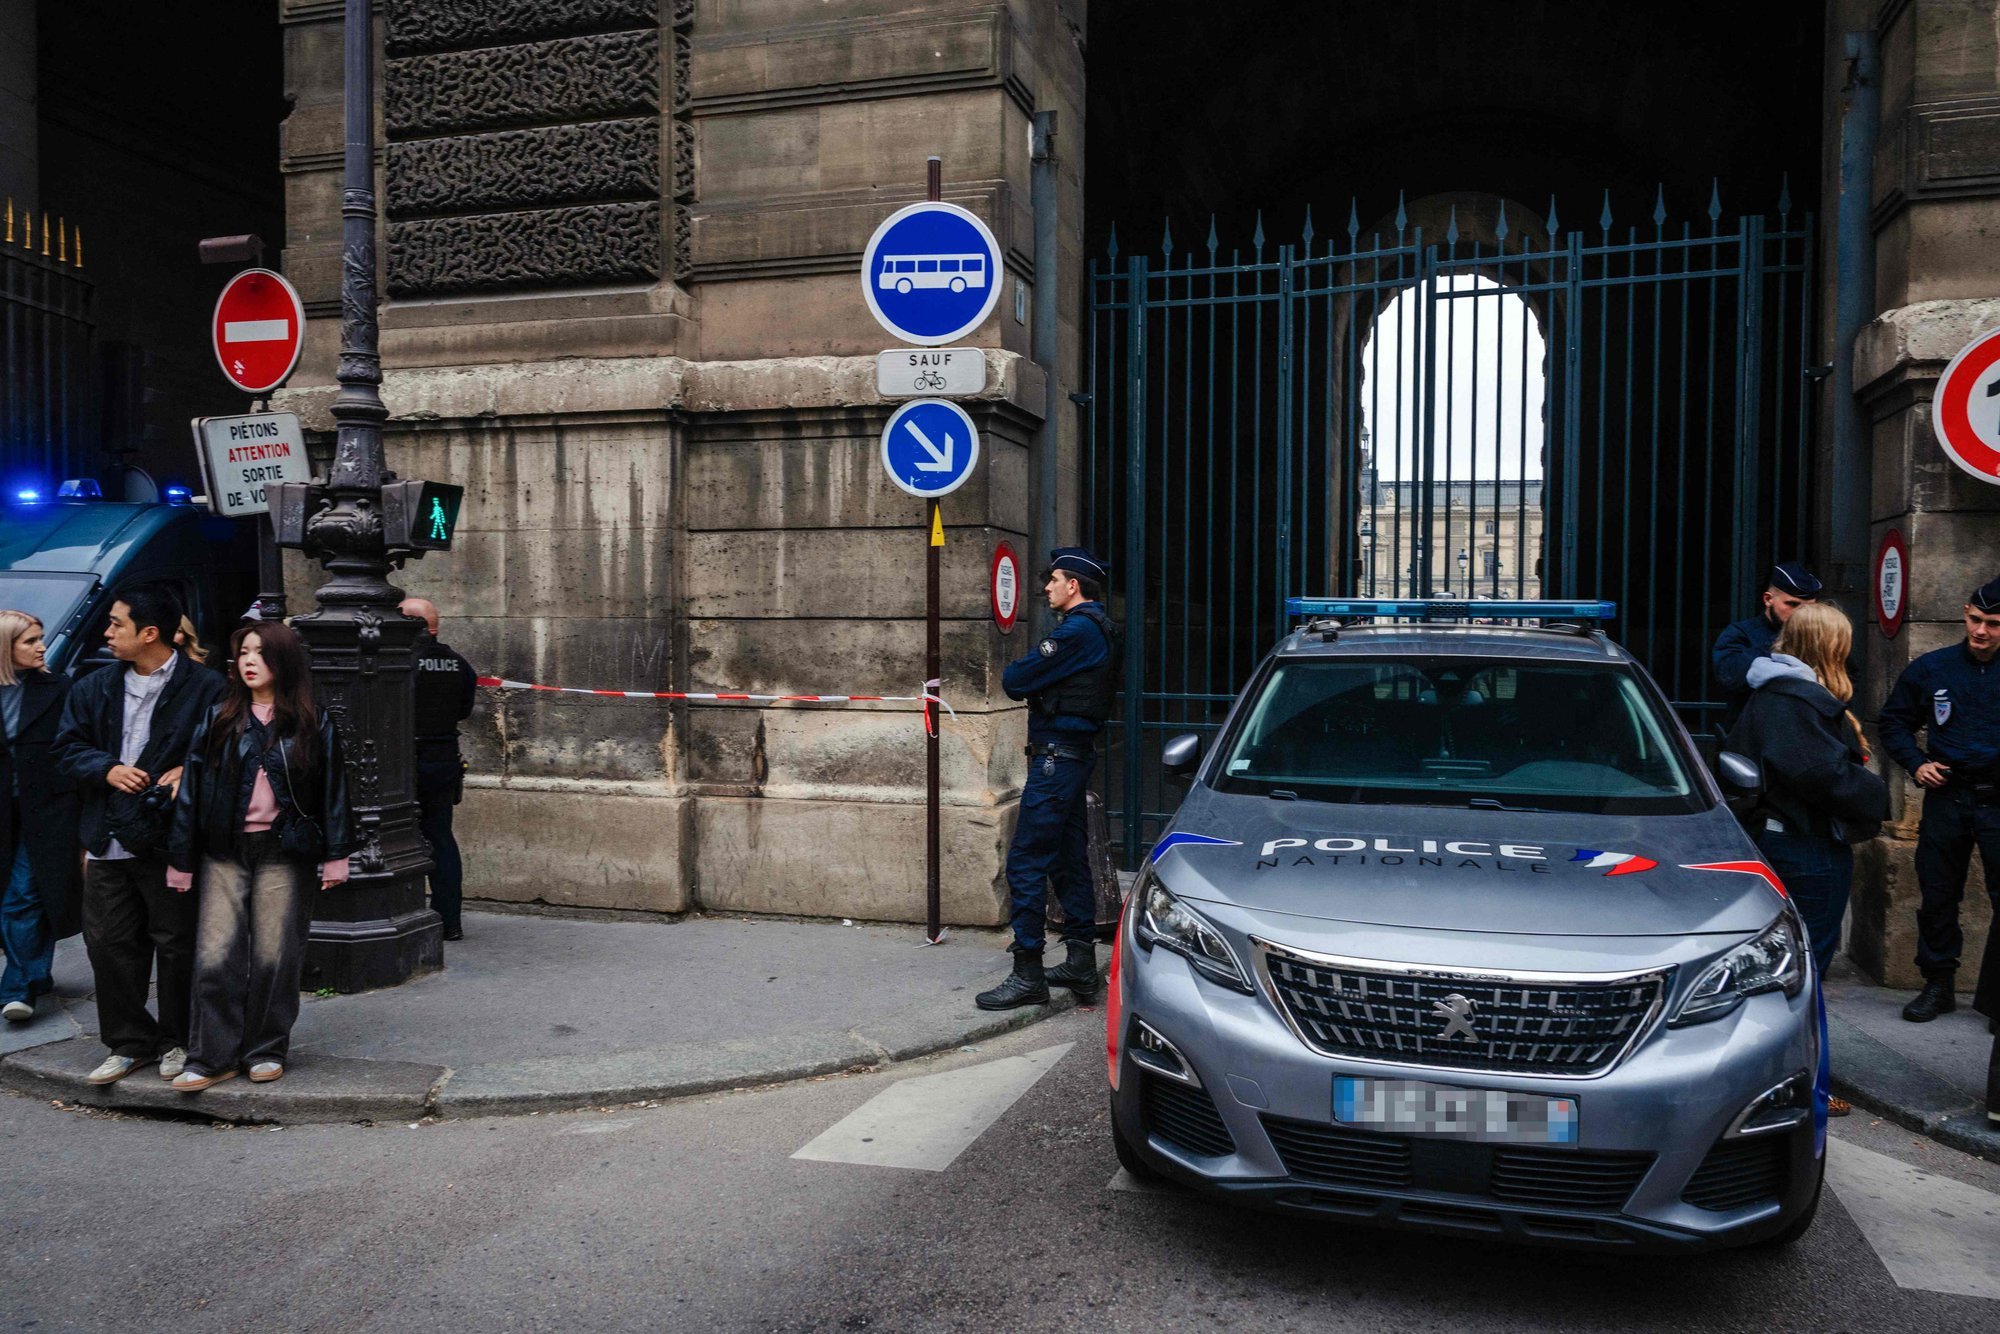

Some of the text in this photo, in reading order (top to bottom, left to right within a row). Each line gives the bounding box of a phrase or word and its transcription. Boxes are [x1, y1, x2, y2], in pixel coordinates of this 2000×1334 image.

[909, 354, 952, 366] SAUF
[230, 421, 279, 440] PIÉTONS
[228, 442, 291, 463] ATTENTION
[242, 465, 284, 483] SORTIE
[227, 492, 244, 507] DE
[418, 658, 459, 671] POLICE
[1260, 838, 1547, 860] POLICE
[1256, 855, 1551, 874] NATIONALE
